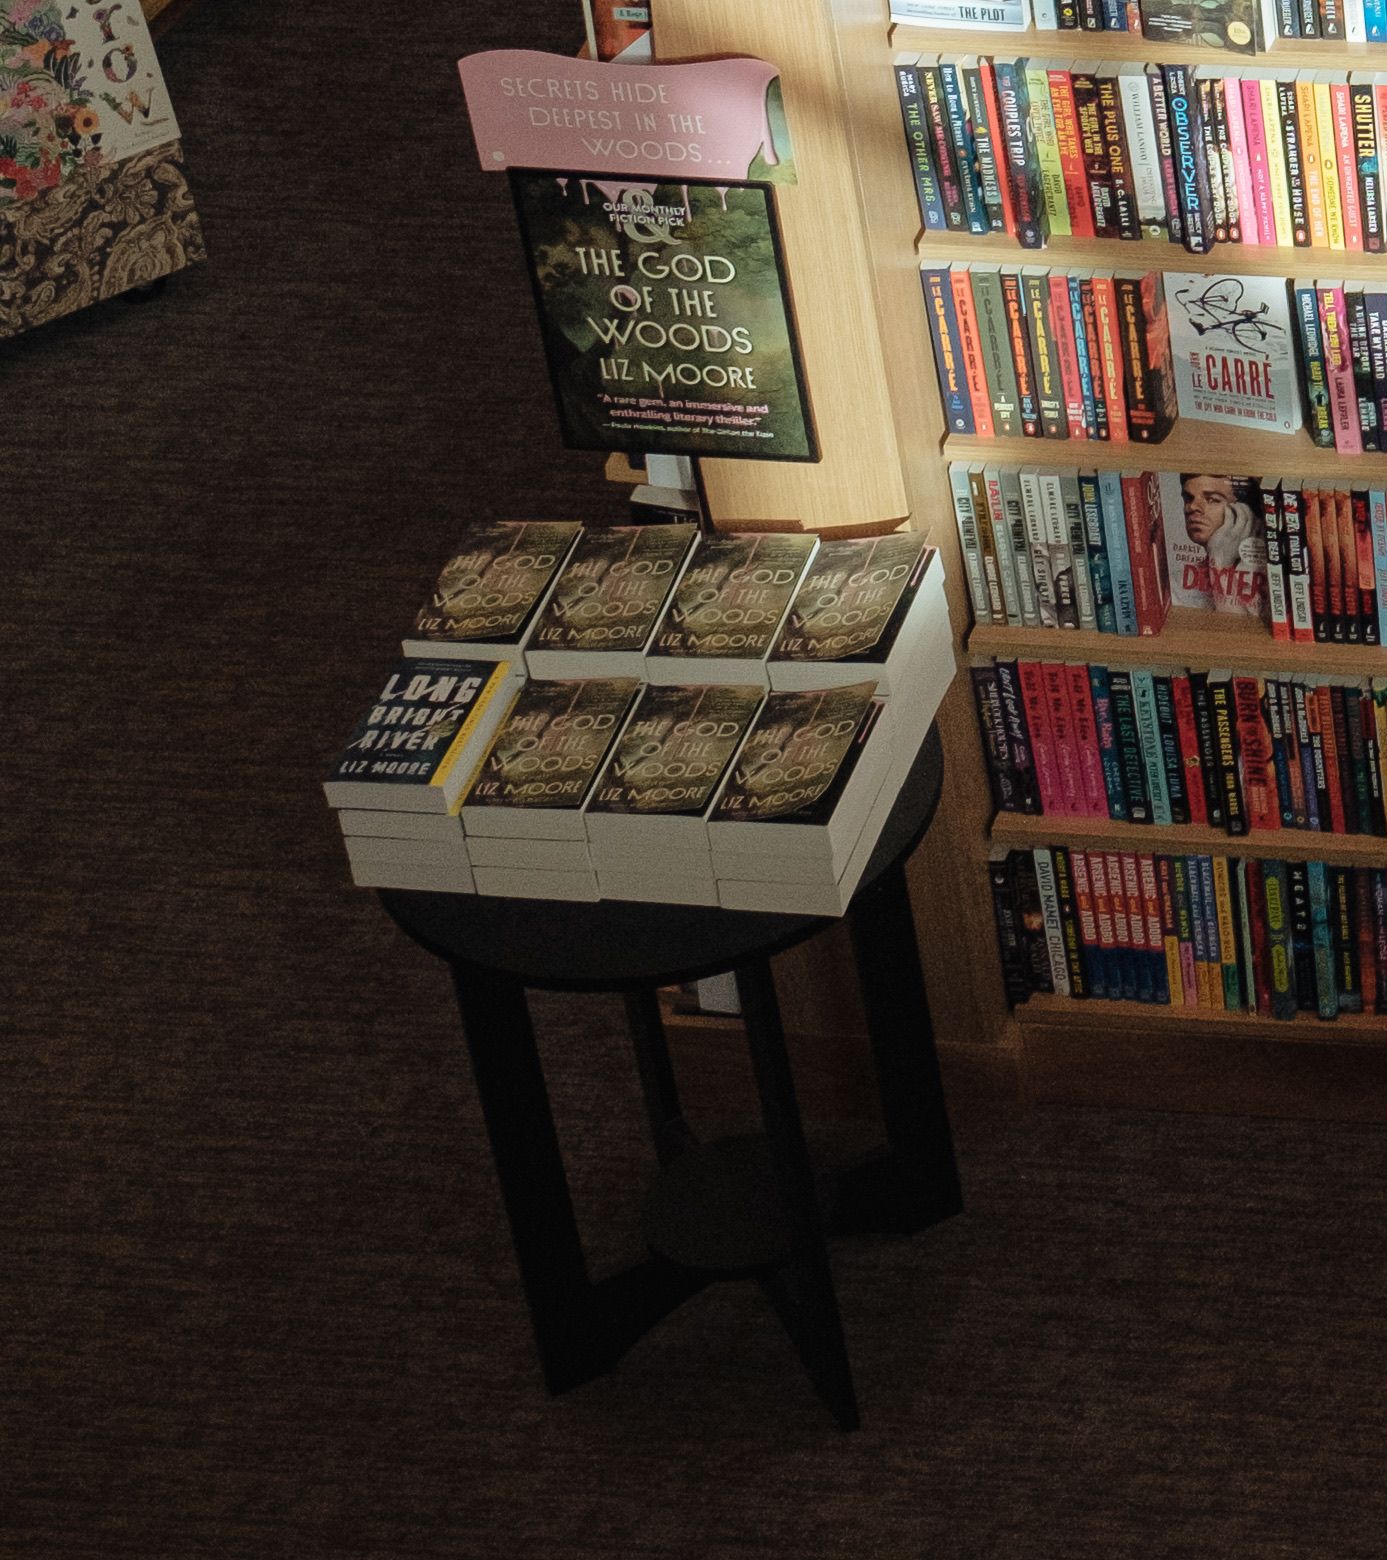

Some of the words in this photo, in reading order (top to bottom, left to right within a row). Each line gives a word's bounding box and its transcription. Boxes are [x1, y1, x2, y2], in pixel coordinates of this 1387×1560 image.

[496, 76, 591, 100] SECRETS
[600, 80, 658, 103] HIDE
[523, 104, 612, 127] DEEPEST
[624, 109, 645, 129] IN
[657, 111, 693, 132] THE
[567, 237, 616, 267] THE
[626, 241, 721, 273] GOD
[600, 272, 643, 301] OF
[655, 275, 702, 306] THE
[578, 302, 737, 341] WOODS
[590, 342, 624, 366] LIZ
[631, 346, 740, 374] MOORE
[1205, 353, 1276, 400] CARRÉ
[381, 672, 483, 703] LONG
[367, 705, 465, 728] BRIGHT
[346, 729, 440, 752] RIVER
